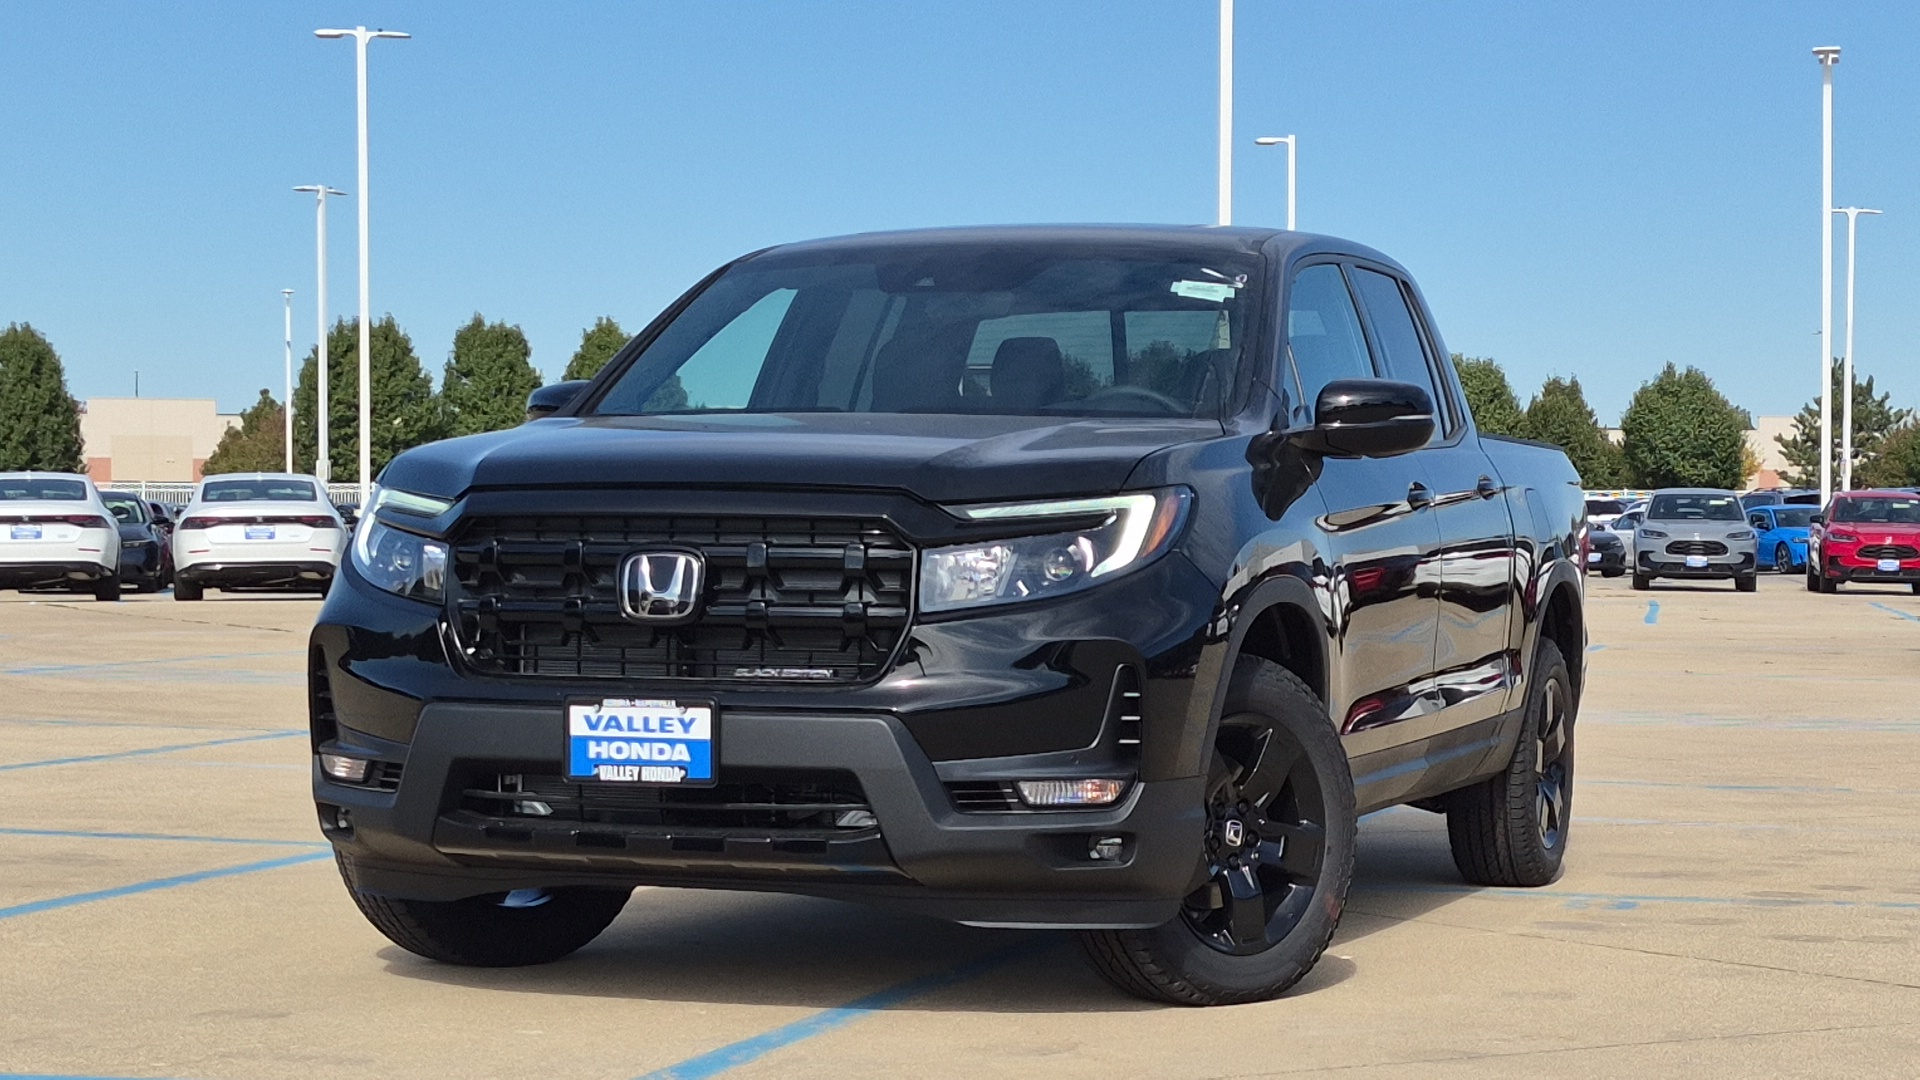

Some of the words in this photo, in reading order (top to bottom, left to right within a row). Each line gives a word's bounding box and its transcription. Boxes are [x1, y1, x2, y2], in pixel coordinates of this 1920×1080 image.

[583, 714, 697, 734] VALLEY
[588, 740, 692, 762] HONDA
[598, 765, 640, 781] VALLEY
[641, 766, 682, 782] HONDA
